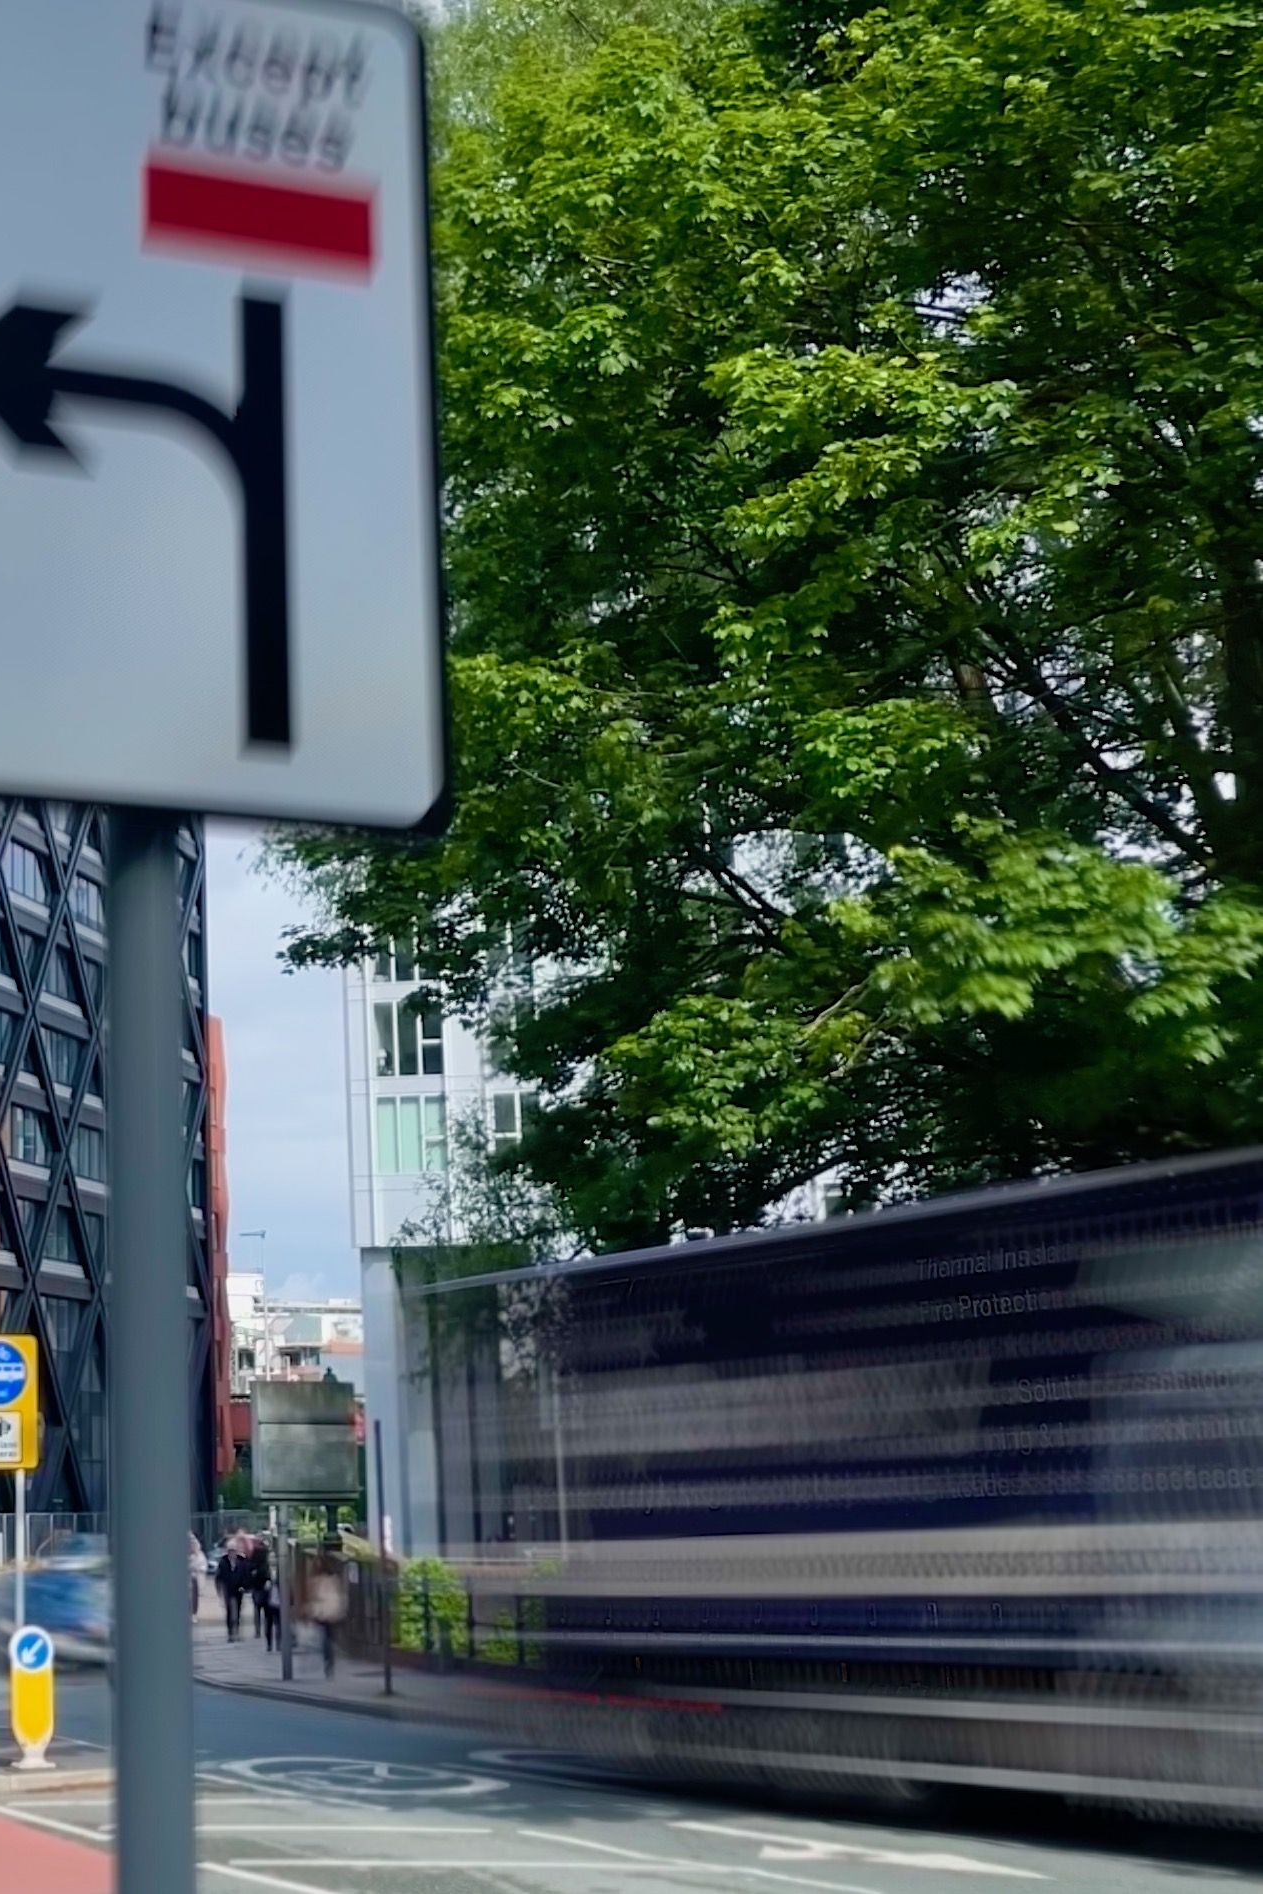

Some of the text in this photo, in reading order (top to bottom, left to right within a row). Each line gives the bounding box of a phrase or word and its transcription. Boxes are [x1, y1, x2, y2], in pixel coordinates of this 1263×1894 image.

[145, 0, 370, 109] Except
[161, 78, 352, 174] buses
[0, 1441, 17, 1449] lane
